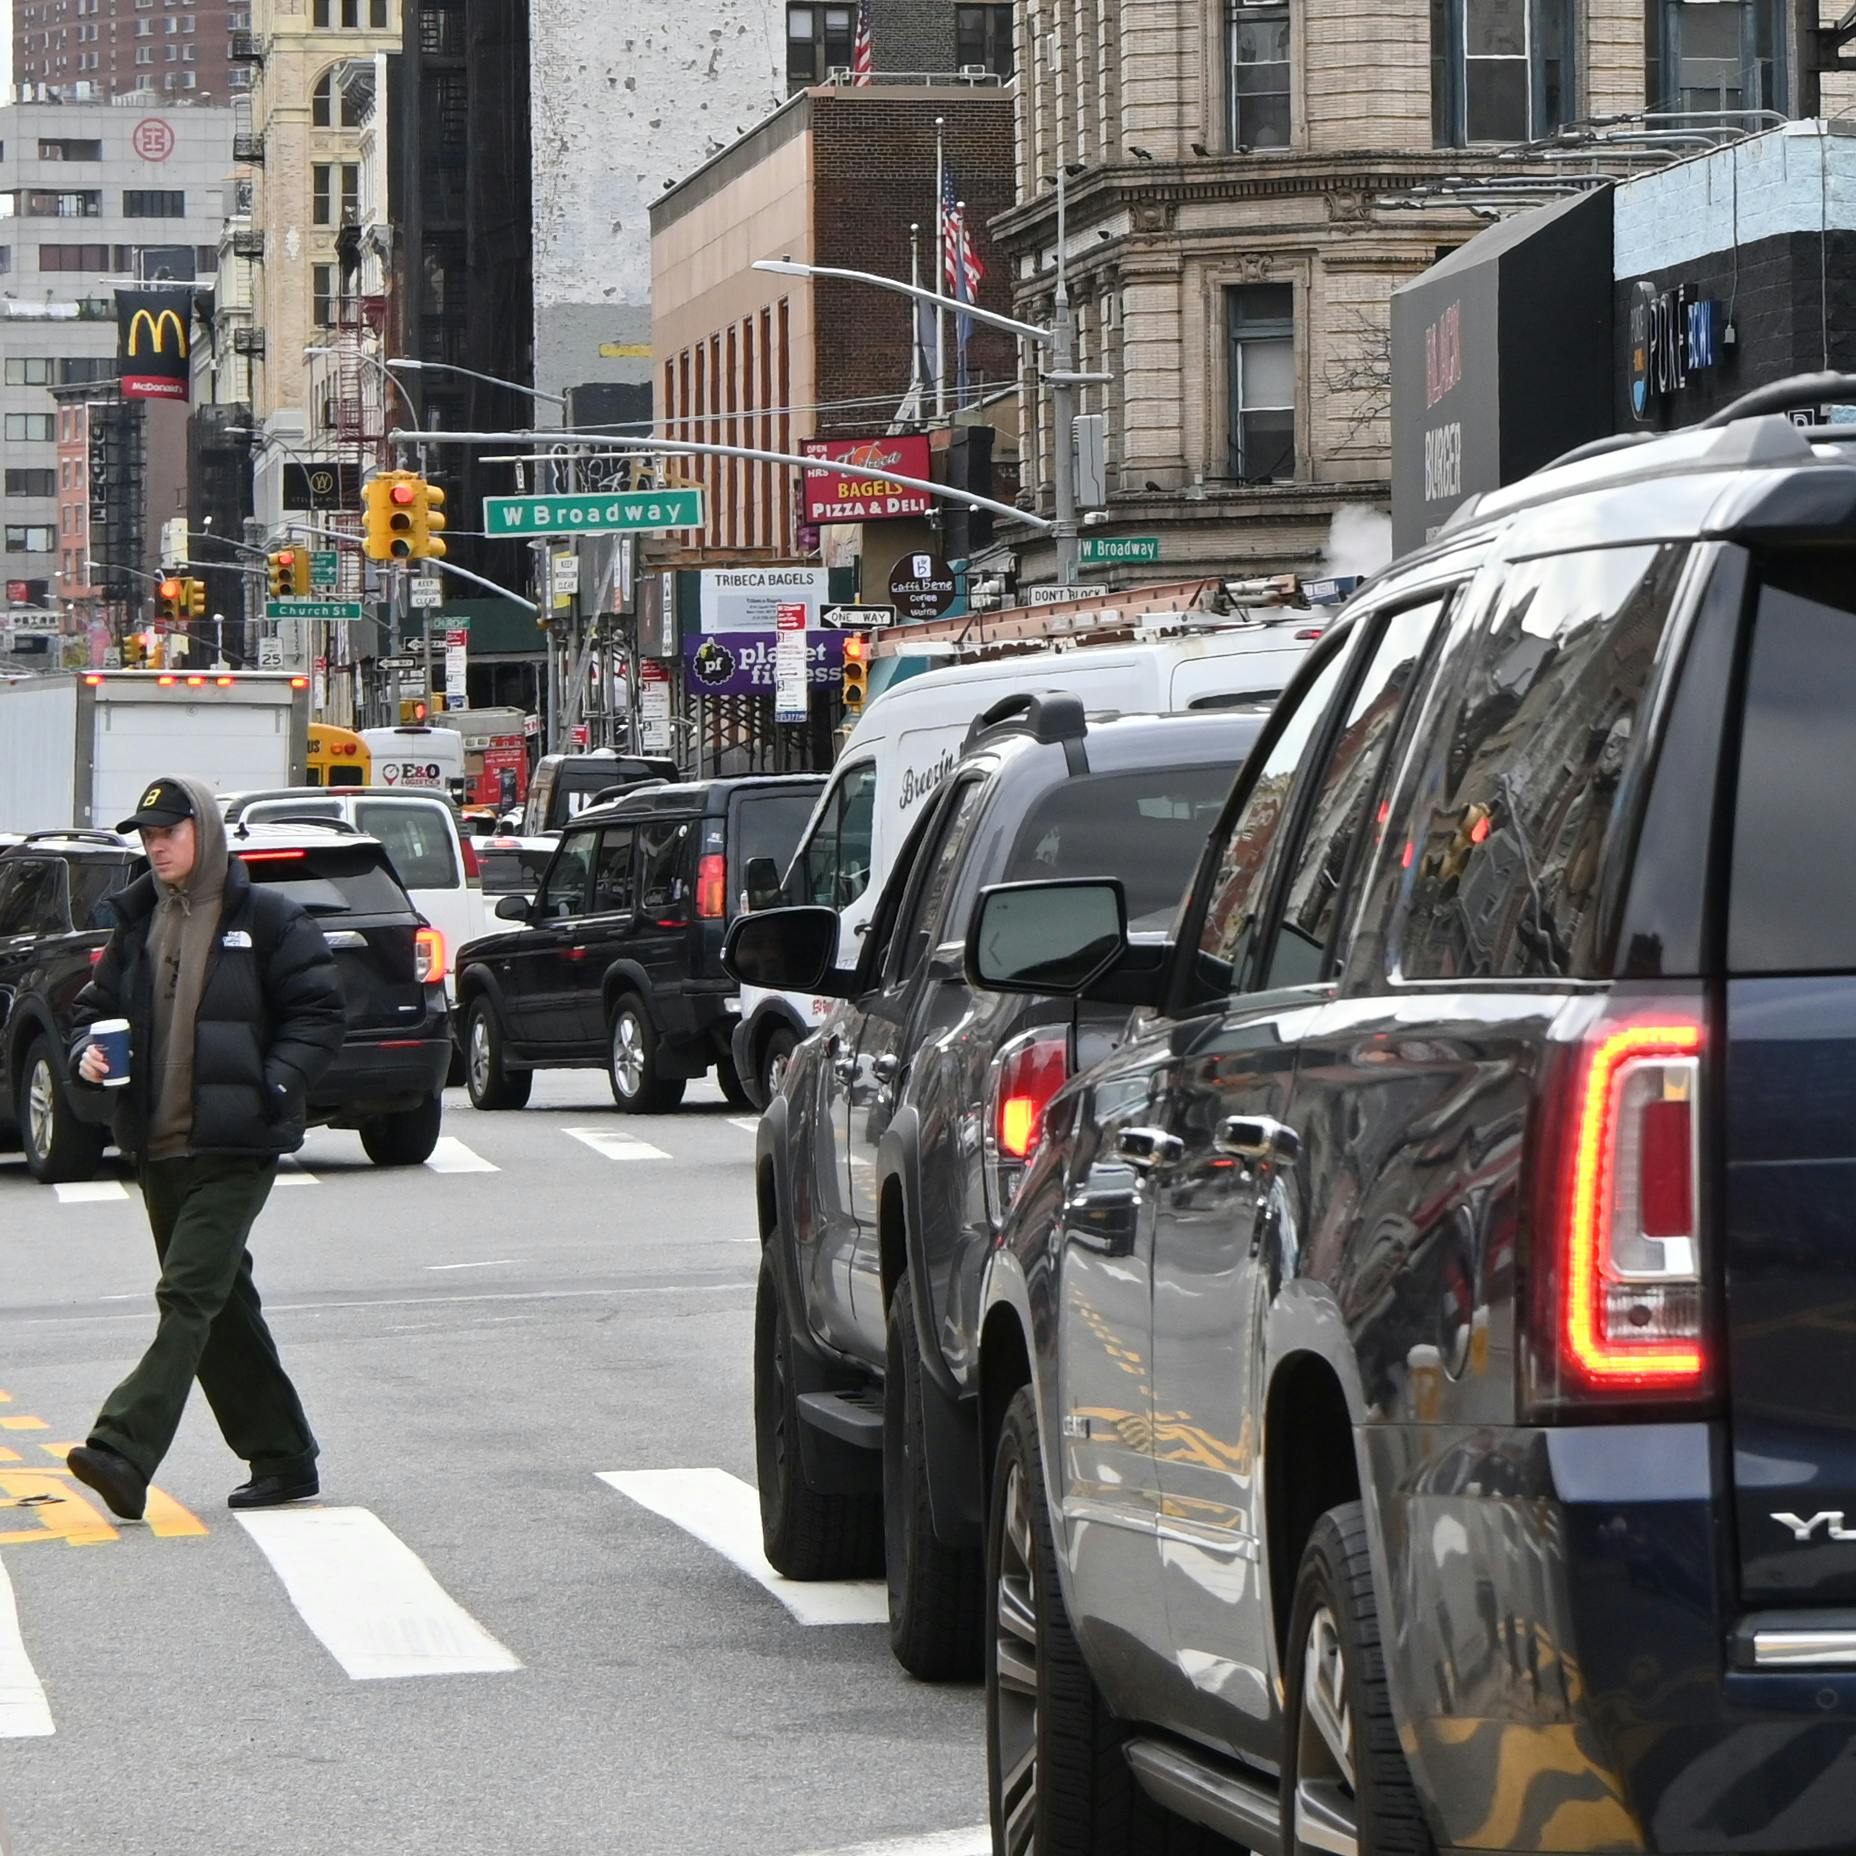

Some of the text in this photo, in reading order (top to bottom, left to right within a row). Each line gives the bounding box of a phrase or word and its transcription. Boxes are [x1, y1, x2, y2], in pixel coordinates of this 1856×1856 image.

[807, 445, 827, 453] OPEN
[1425, 422, 1460, 501] BURGER
[838, 479, 903, 498] BAGELS
[503, 503, 681, 526] W Broadway
[812, 498, 925, 518] PIZZA & DELI
[1082, 541, 1155, 559] W Broadway
[715, 573, 814, 587] TRIBECA BAGELS
[1035, 590, 1064, 601] DON'T
[279, 606, 347, 615] Church St
[831, 612, 886, 622] ONE WAY
[262, 653, 281, 665] 25
[739, 642, 826, 670] plaet
[704, 657, 723, 673] pf
[751, 665, 841, 685] fitess
[307, 740, 320, 754] US
[402, 764, 440, 778] E&O
